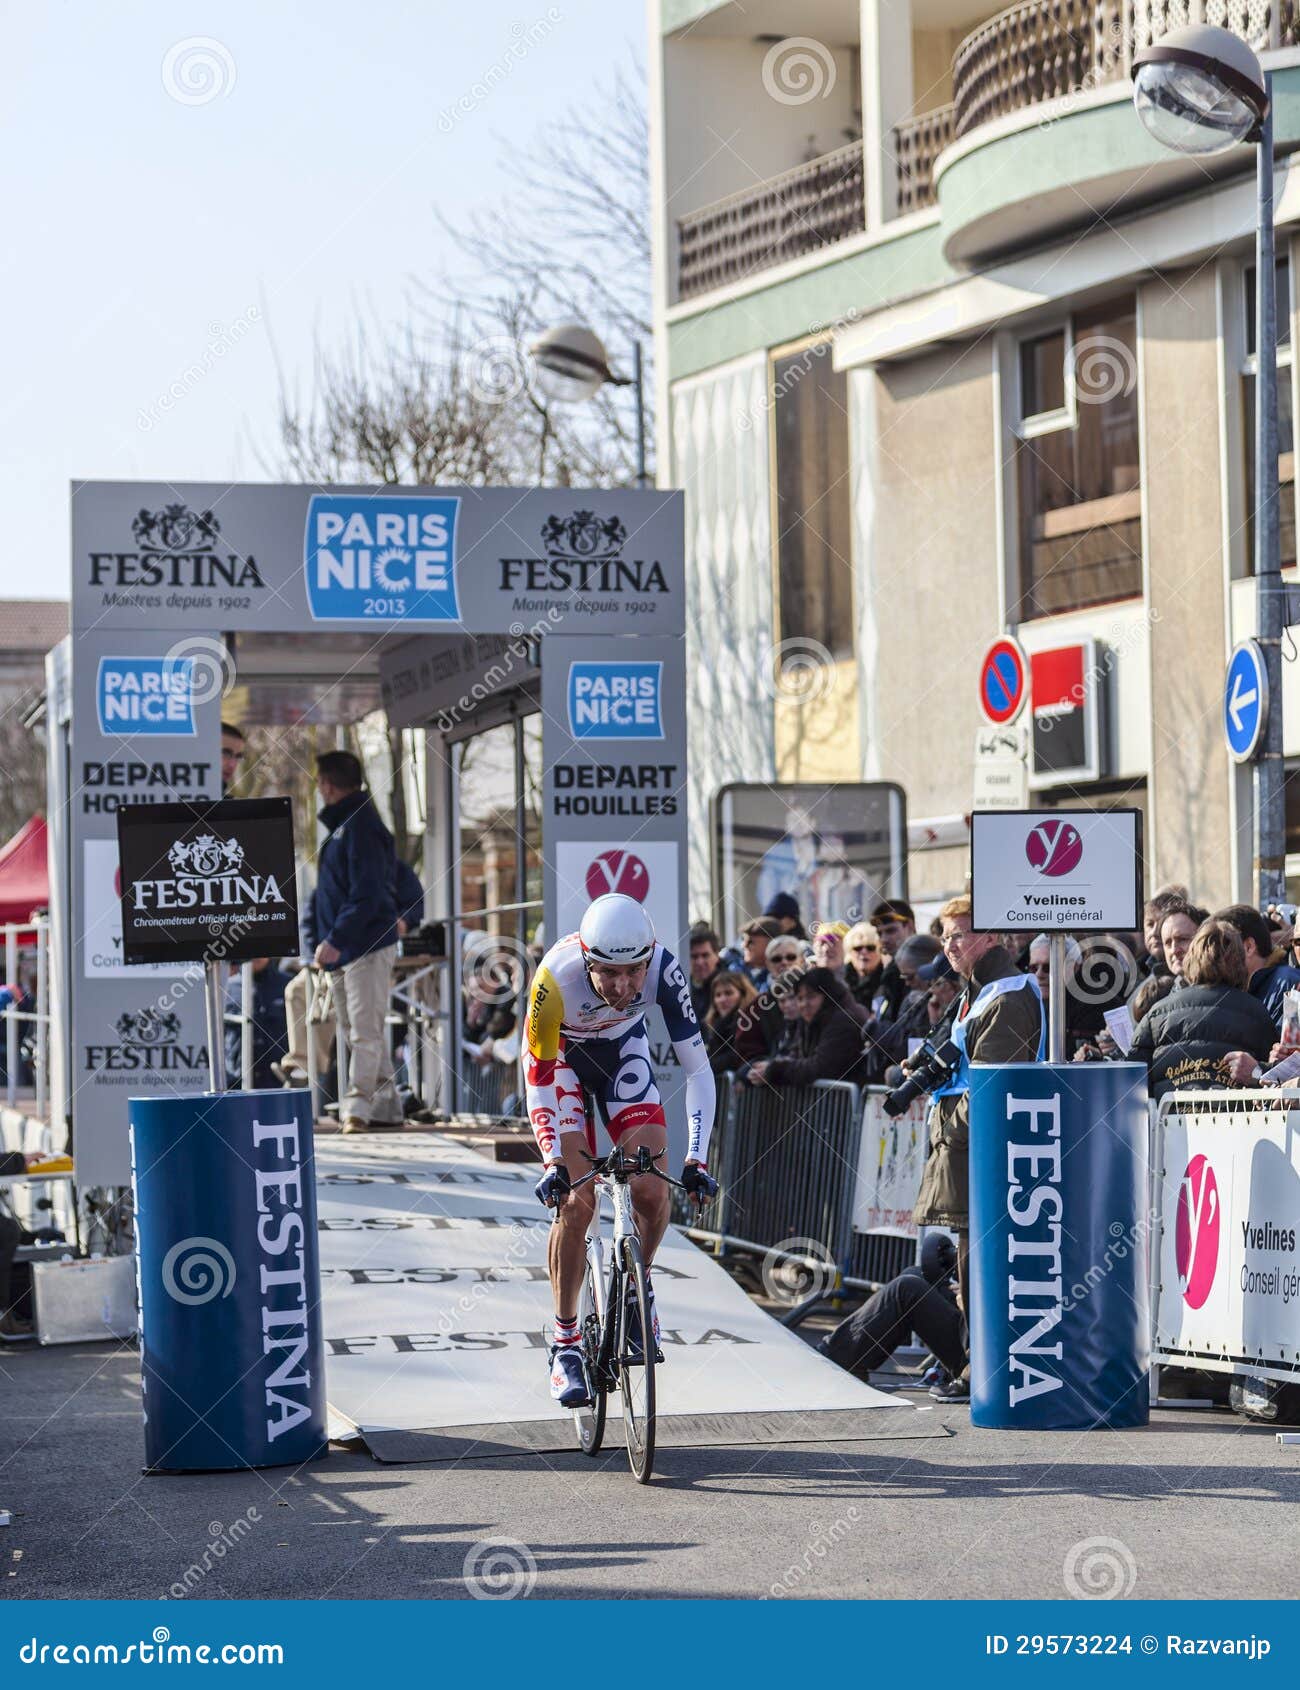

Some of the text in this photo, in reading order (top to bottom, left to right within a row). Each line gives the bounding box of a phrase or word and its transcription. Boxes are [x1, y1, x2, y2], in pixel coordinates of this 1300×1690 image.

[316, 511, 448, 547] PARIS
[88, 553, 264, 588] FESTINA
[317, 546, 448, 593] NICE
[499, 557, 670, 593] FESTINA
[102, 592, 252, 611] Montres depuis 1902
[364, 598, 406, 616] 2013
[512, 597, 657, 616] Montres depuis 1902
[105, 672, 188, 694] PARIS
[575, 676, 656, 698] PARIS
[105, 696, 188, 721] NICE
[575, 699, 656, 725] NICE
[83, 762, 210, 788] DEPART
[554, 765, 677, 789] DEPART
[554, 796, 677, 816] HOUILLES
[132, 874, 285, 911] FESTINA
[1024, 895, 1086, 906] Yvelines
[133, 915, 195, 928] Chronométreur
[198, 913, 228, 924] Officiel
[271, 912, 286, 921] ans
[1006, 909, 1103, 924] Conseil général
[609, 946, 636, 954] LAZER
[85, 1046, 210, 1071] FESTINA
[95, 1073, 204, 1087] Montres depuis 1902
[690, 1109, 702, 1153] BELISOL
[1242, 1221, 1296, 1252] Yvelines
[1006, 1093, 1063, 1408] FESTINA
[252, 1116, 312, 1443] FESTINA
[1240, 1264, 1280, 1295] Conseil
[325, 1328, 761, 1357] FESTA
